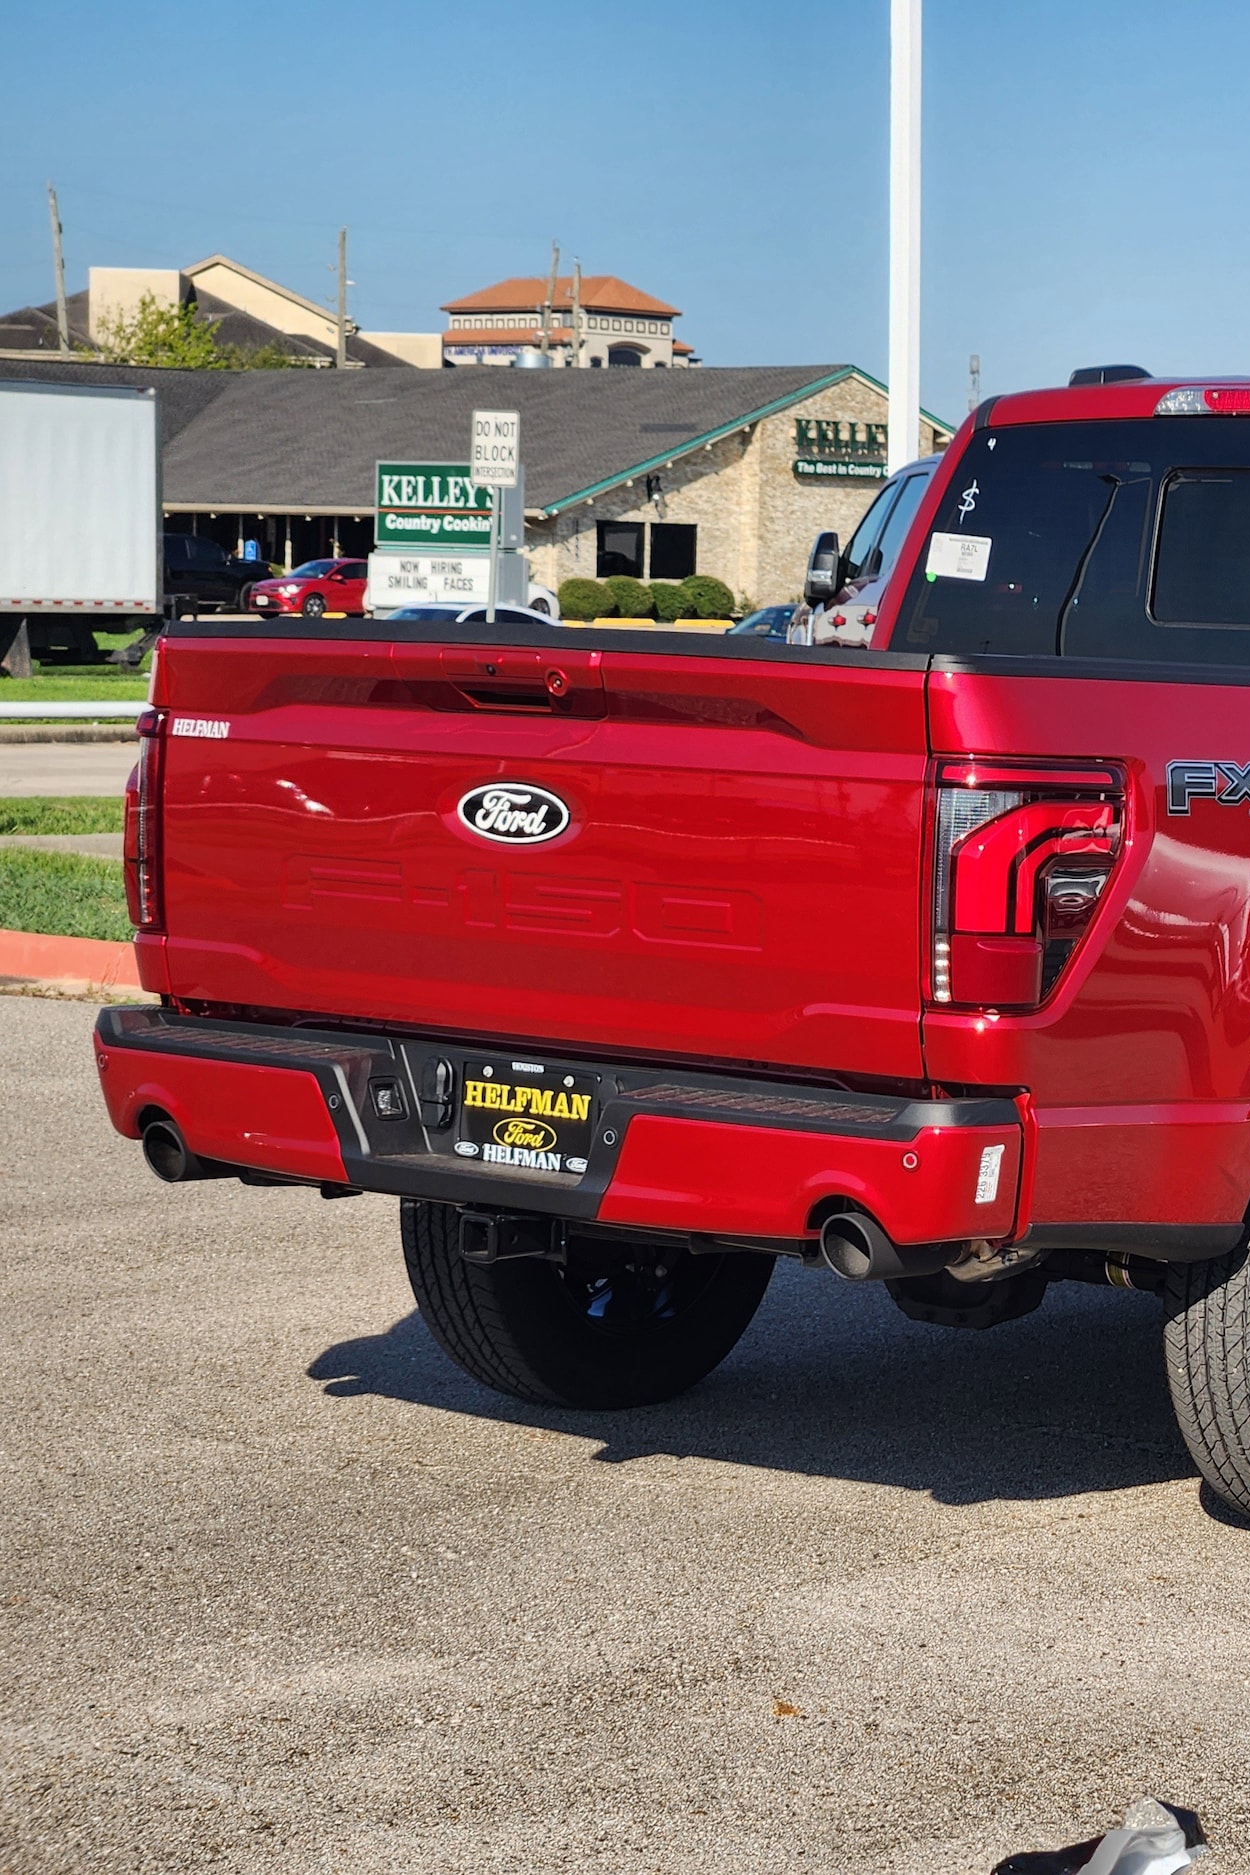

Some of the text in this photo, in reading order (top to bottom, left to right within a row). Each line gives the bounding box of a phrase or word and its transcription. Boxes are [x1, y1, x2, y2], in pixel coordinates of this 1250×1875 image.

[476, 421, 516, 438] DO NOT
[796, 419, 888, 452] KELLE
[475, 445, 515, 462] BLOCK
[474, 467, 515, 479] INTERSECTION
[797, 462, 815, 473] The
[816, 463, 837, 474] Best
[848, 465, 881, 478] Country
[380, 475, 494, 508] KELLEY
[385, 513, 441, 534] Country
[400, 560, 463, 575] NOW HIRING
[388, 575, 474, 591] SMILING FACES
[172, 718, 231, 739] HELFMAN
[474, 789, 550, 836] Ford
[282, 852, 764, 952] F-150
[464, 1081, 592, 1121] HELFMAN
[503, 1121, 546, 1148] Ford
[482, 1143, 562, 1171] HELFMAN
